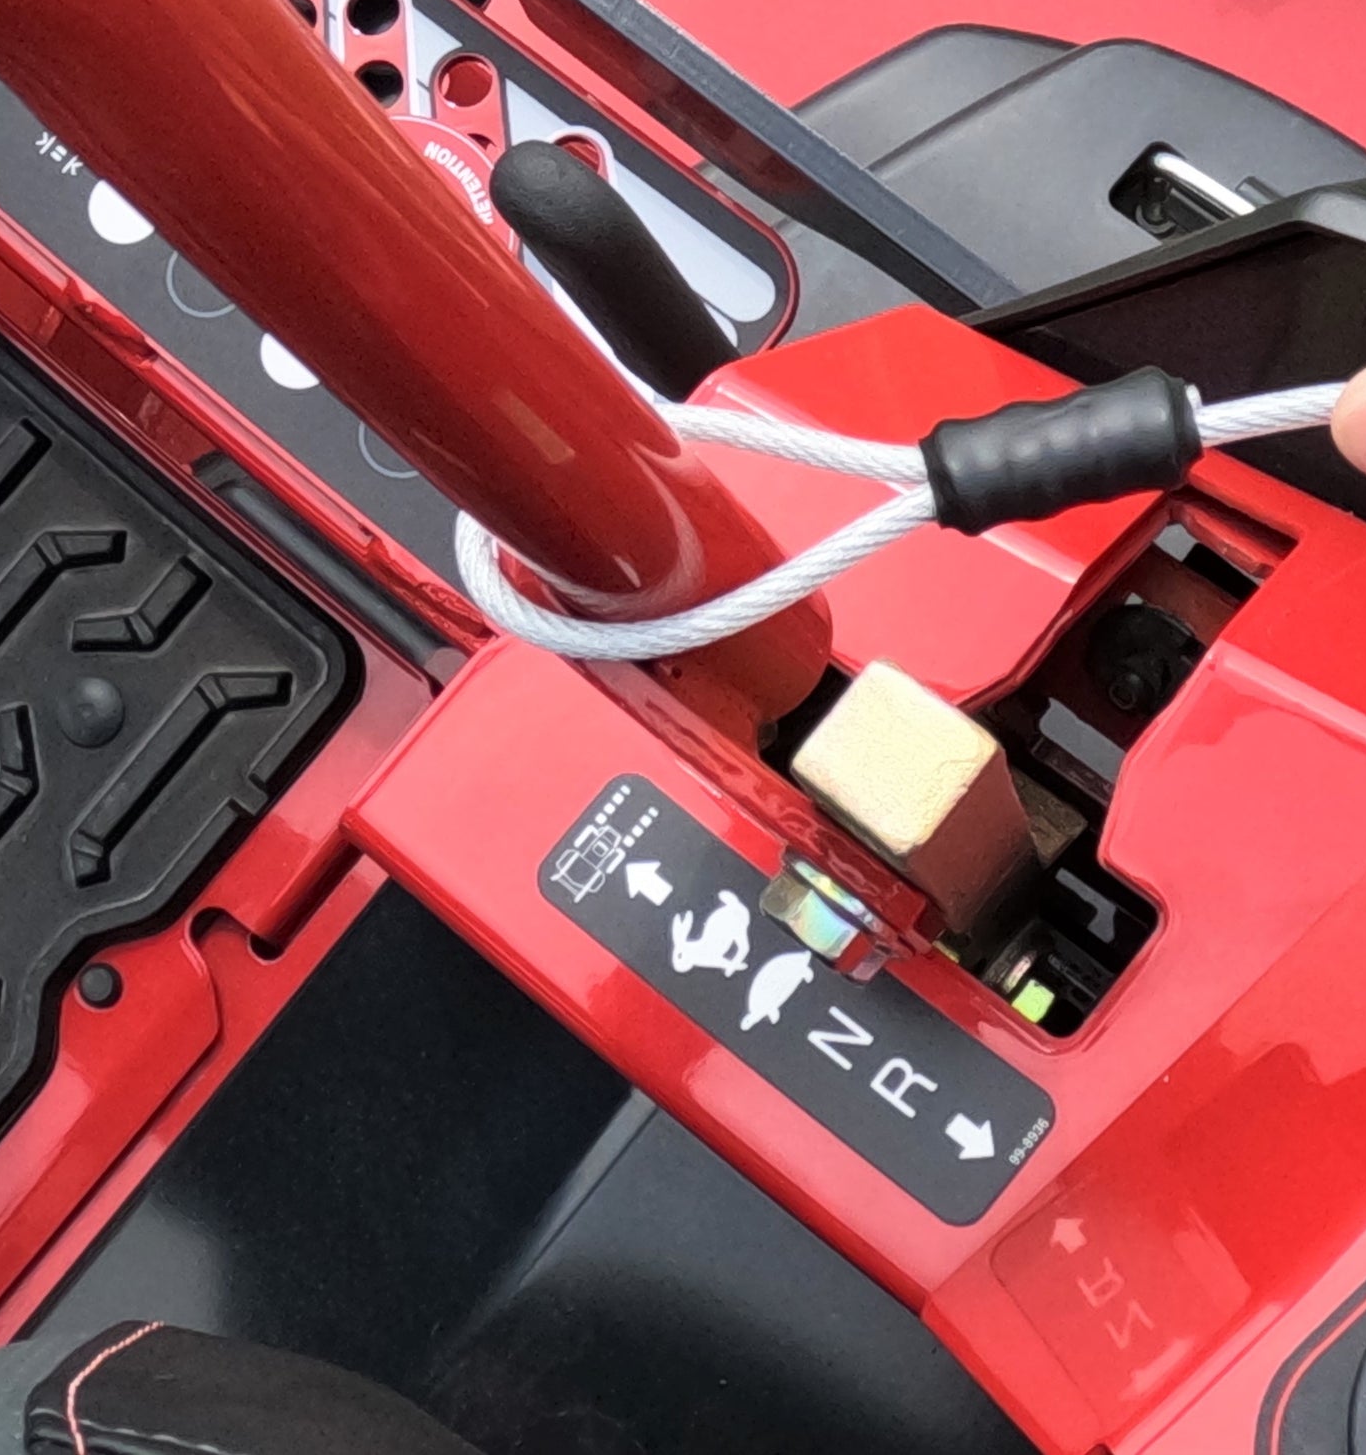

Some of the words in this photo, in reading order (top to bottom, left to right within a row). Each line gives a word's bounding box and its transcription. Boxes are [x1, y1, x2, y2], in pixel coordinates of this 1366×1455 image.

[807, 1006, 874, 1071] N
[870, 1057, 938, 1118] R
[1008, 1117, 1050, 1166] 99-8936
